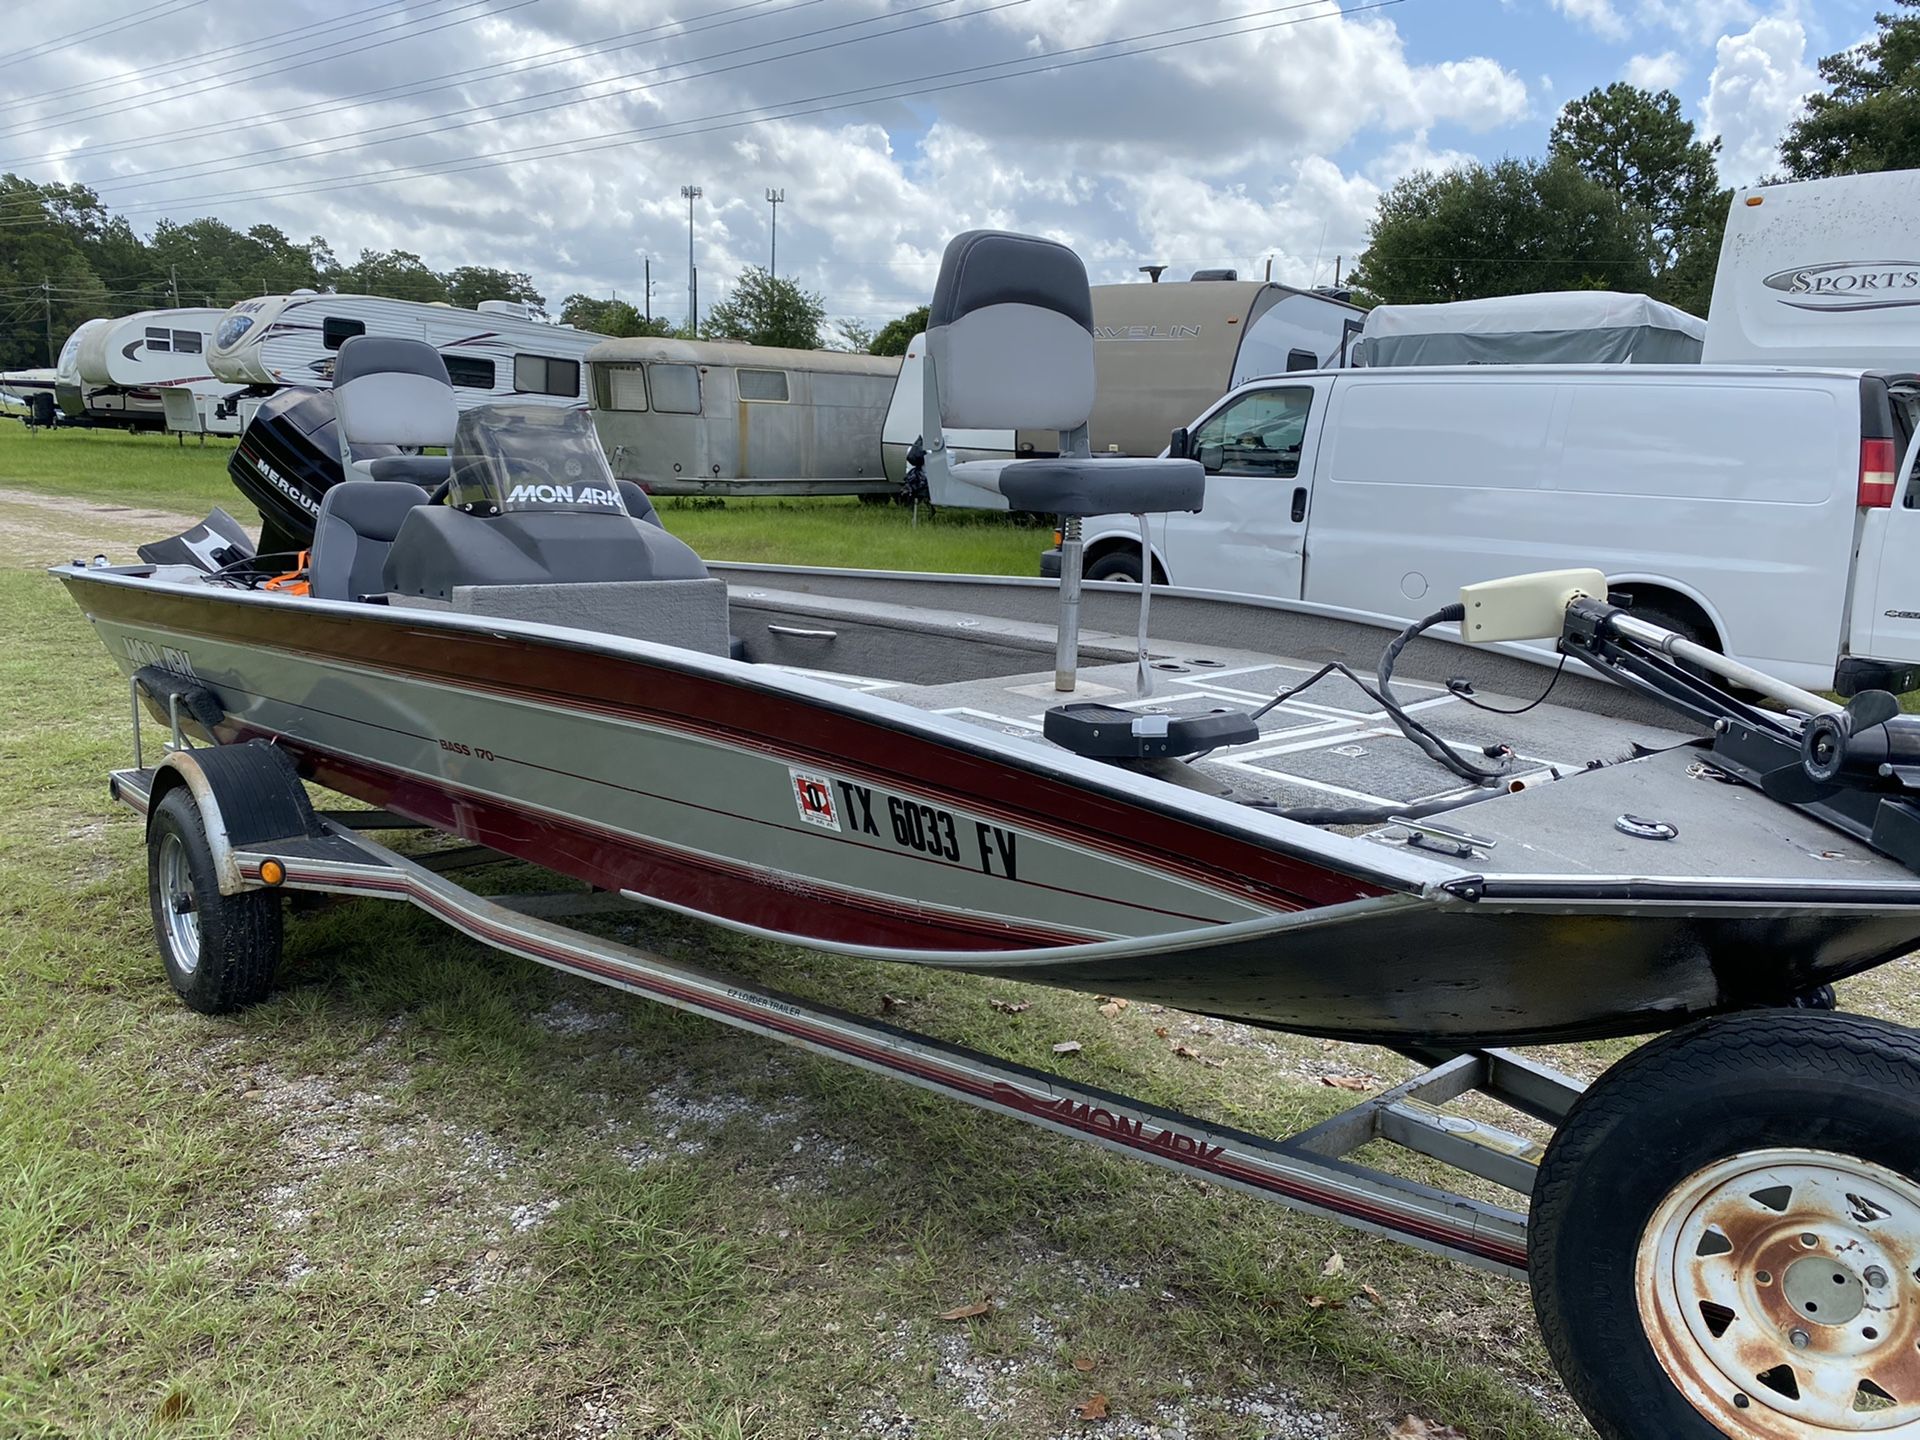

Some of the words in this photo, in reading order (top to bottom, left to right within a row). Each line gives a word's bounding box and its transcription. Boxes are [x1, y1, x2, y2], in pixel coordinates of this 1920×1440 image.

[1788, 270, 1919, 294] SPORTS
[439, 739, 471, 756] BASS
[474, 747, 495, 761] 170
[837, 780, 880, 837] TX
[887, 796, 960, 862] 6033
[975, 821, 1017, 881] FV
[727, 988, 738, 998] EZ
[768, 1001, 801, 1017] TRAILER
